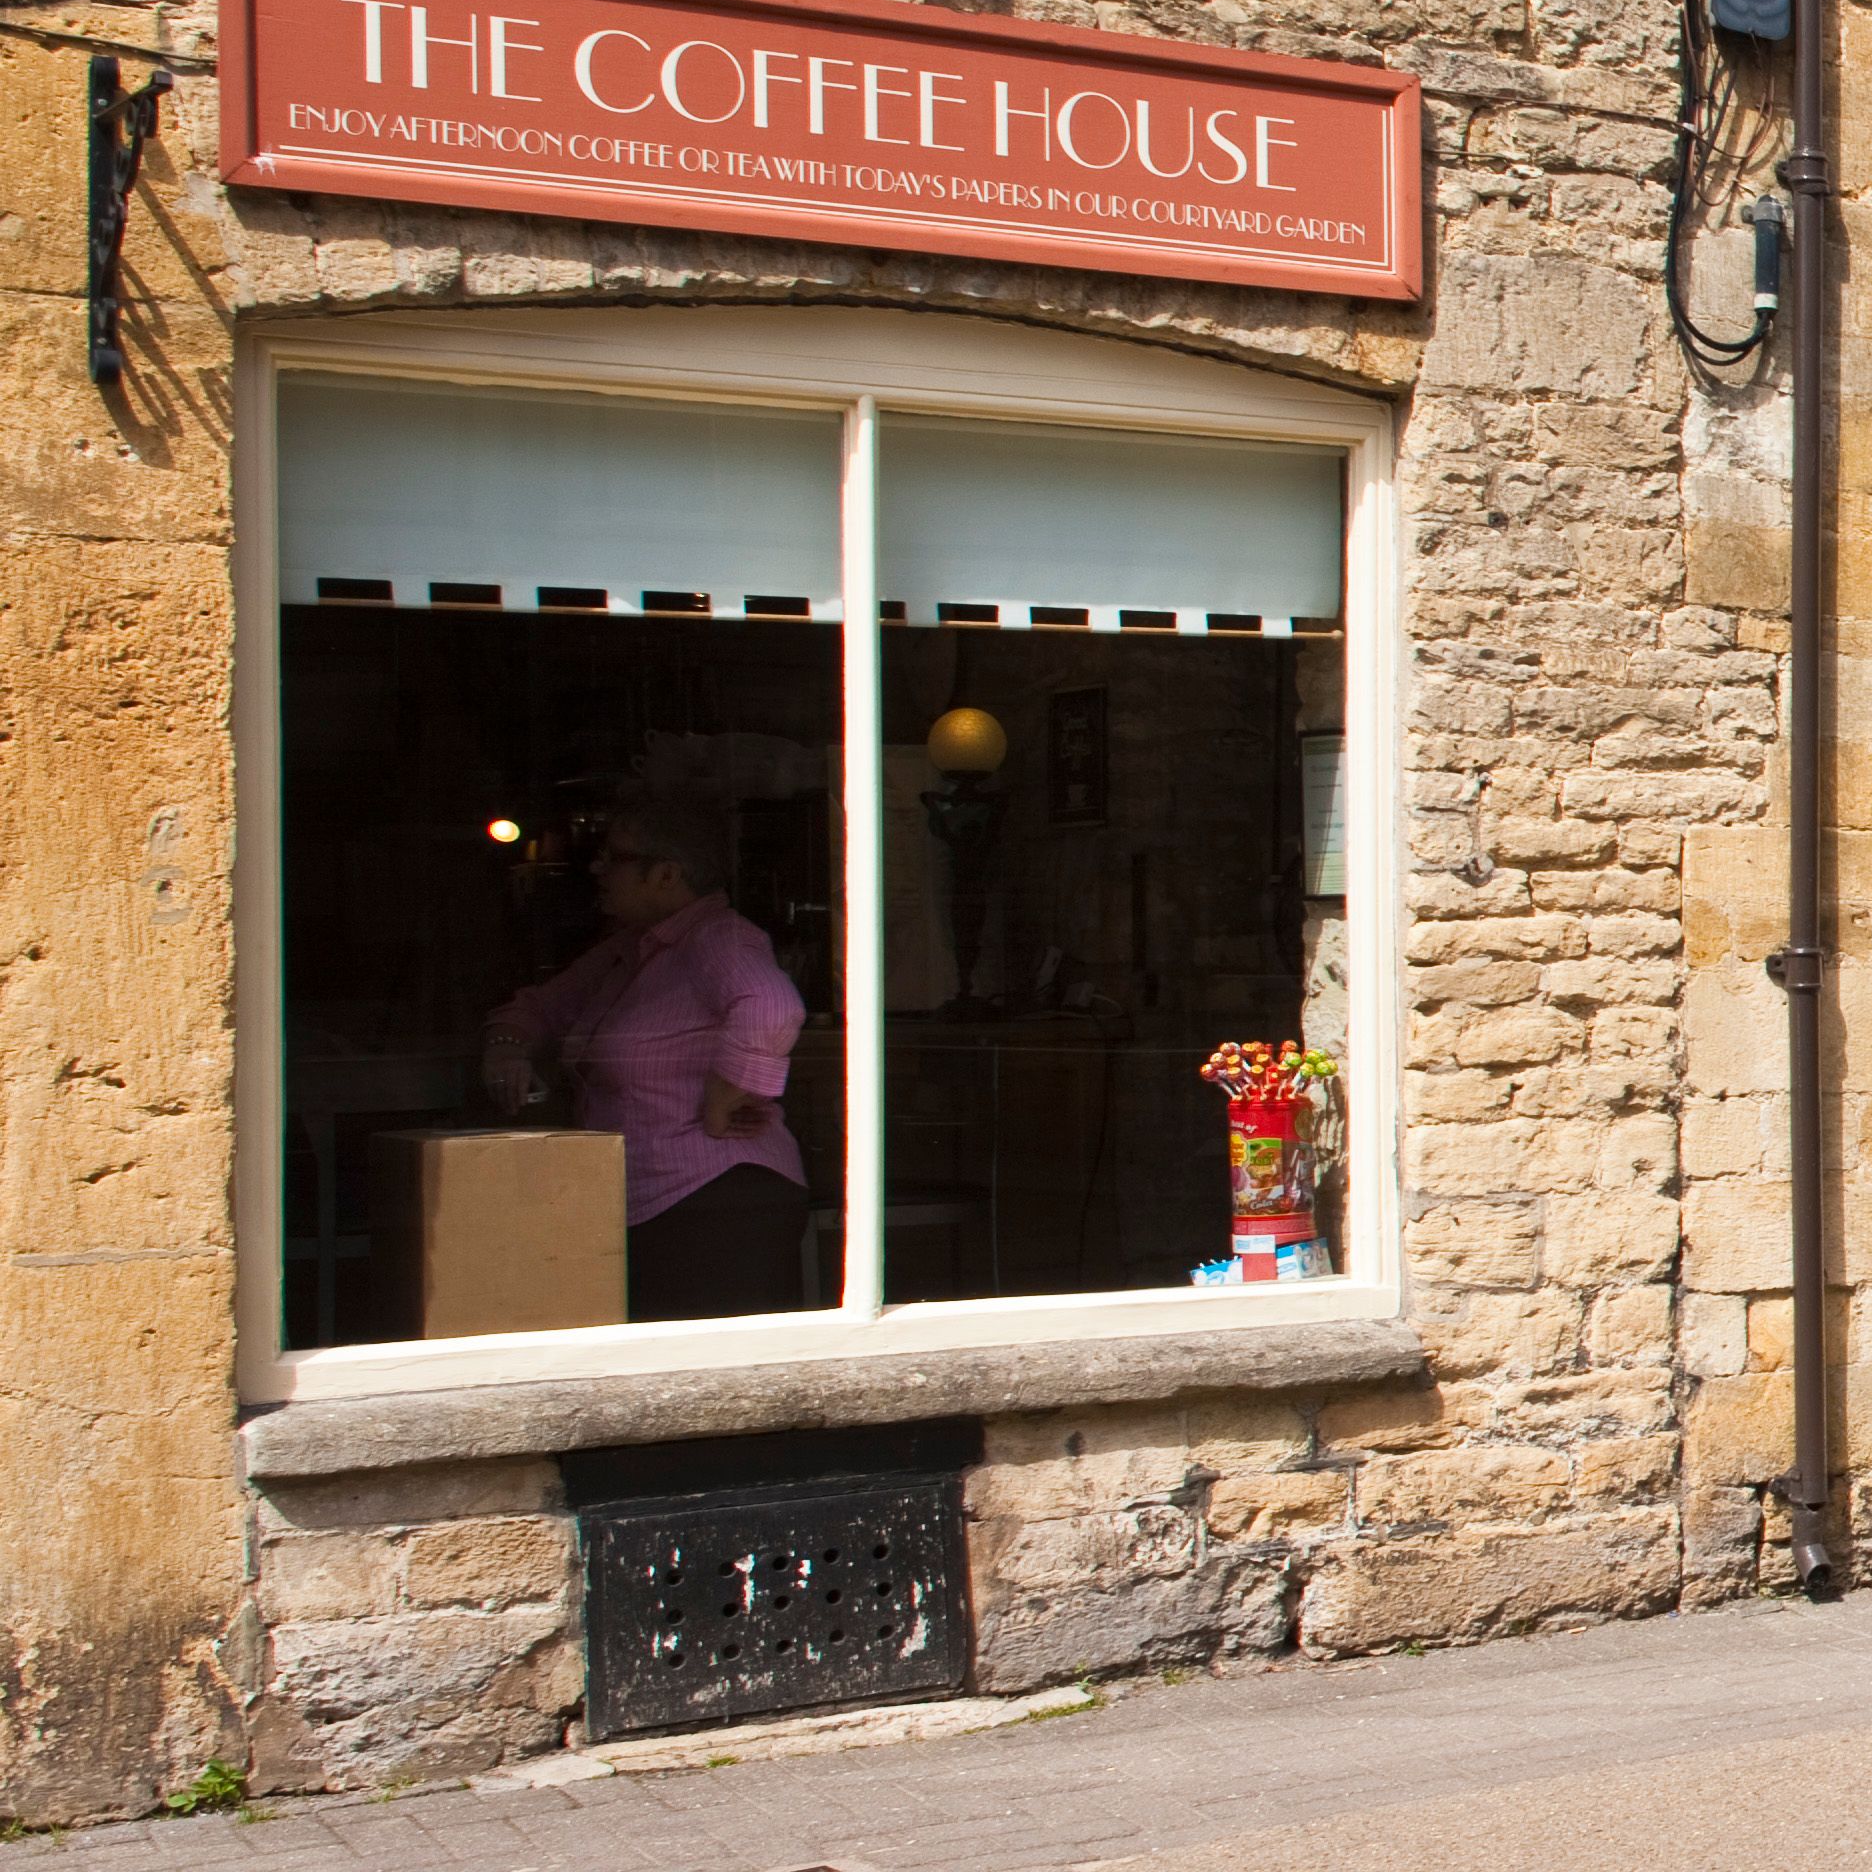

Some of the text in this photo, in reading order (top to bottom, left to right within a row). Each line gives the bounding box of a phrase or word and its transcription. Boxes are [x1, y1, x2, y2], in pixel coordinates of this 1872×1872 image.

[289, 103, 1366, 246] ENJOY AFTERNOON COFFEE OR TEA WITH TODAY'S PAPERS IN OUR COURTYARD GARDEN
[573, 29, 968, 152] COFFEE
[993, 80, 1299, 192] HOUSE
